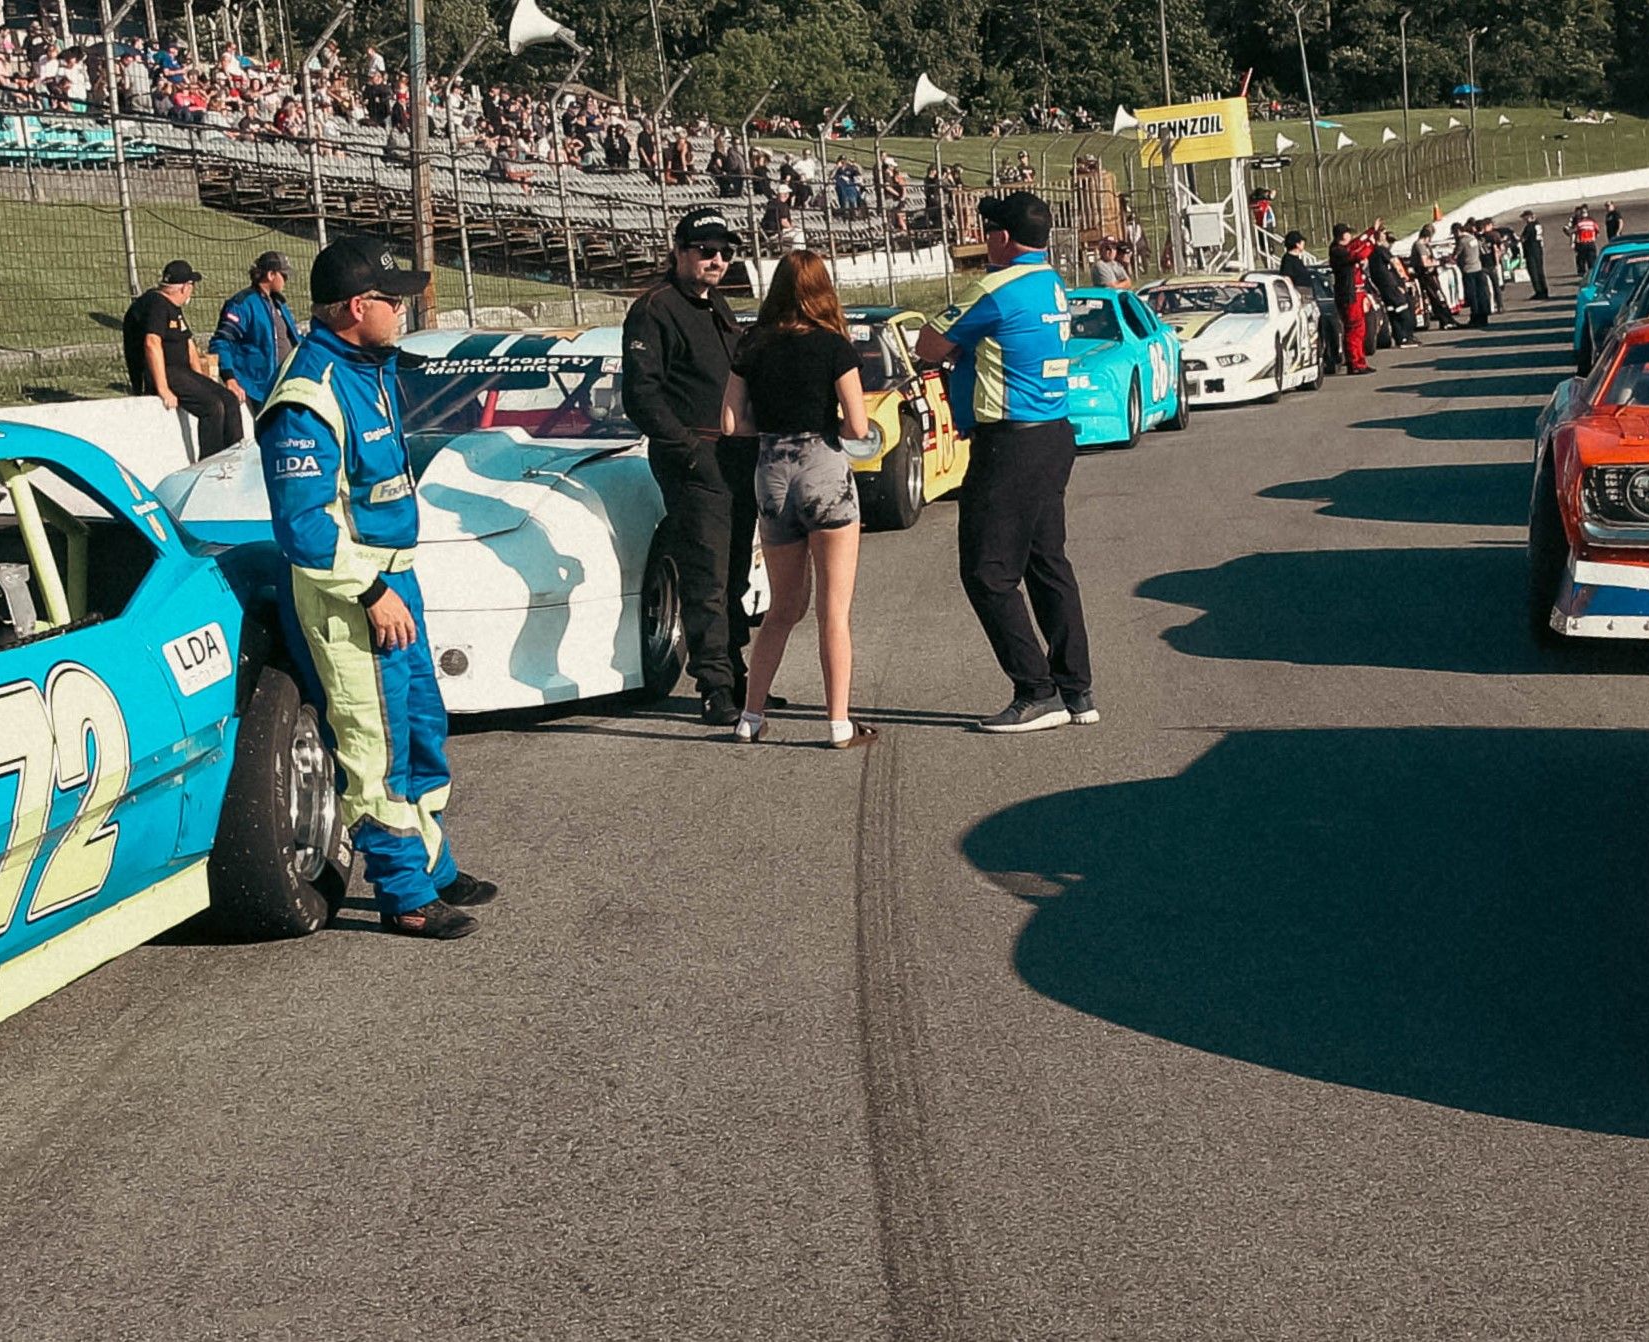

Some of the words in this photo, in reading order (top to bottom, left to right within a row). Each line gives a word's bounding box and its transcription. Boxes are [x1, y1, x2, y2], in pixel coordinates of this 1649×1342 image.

[1147, 115, 1224, 139] PENNZOIL
[419, 357, 492, 369] xtator
[497, 355, 594, 367] Property
[425, 364, 560, 376] Maintenance
[174, 630, 222, 671] LDA
